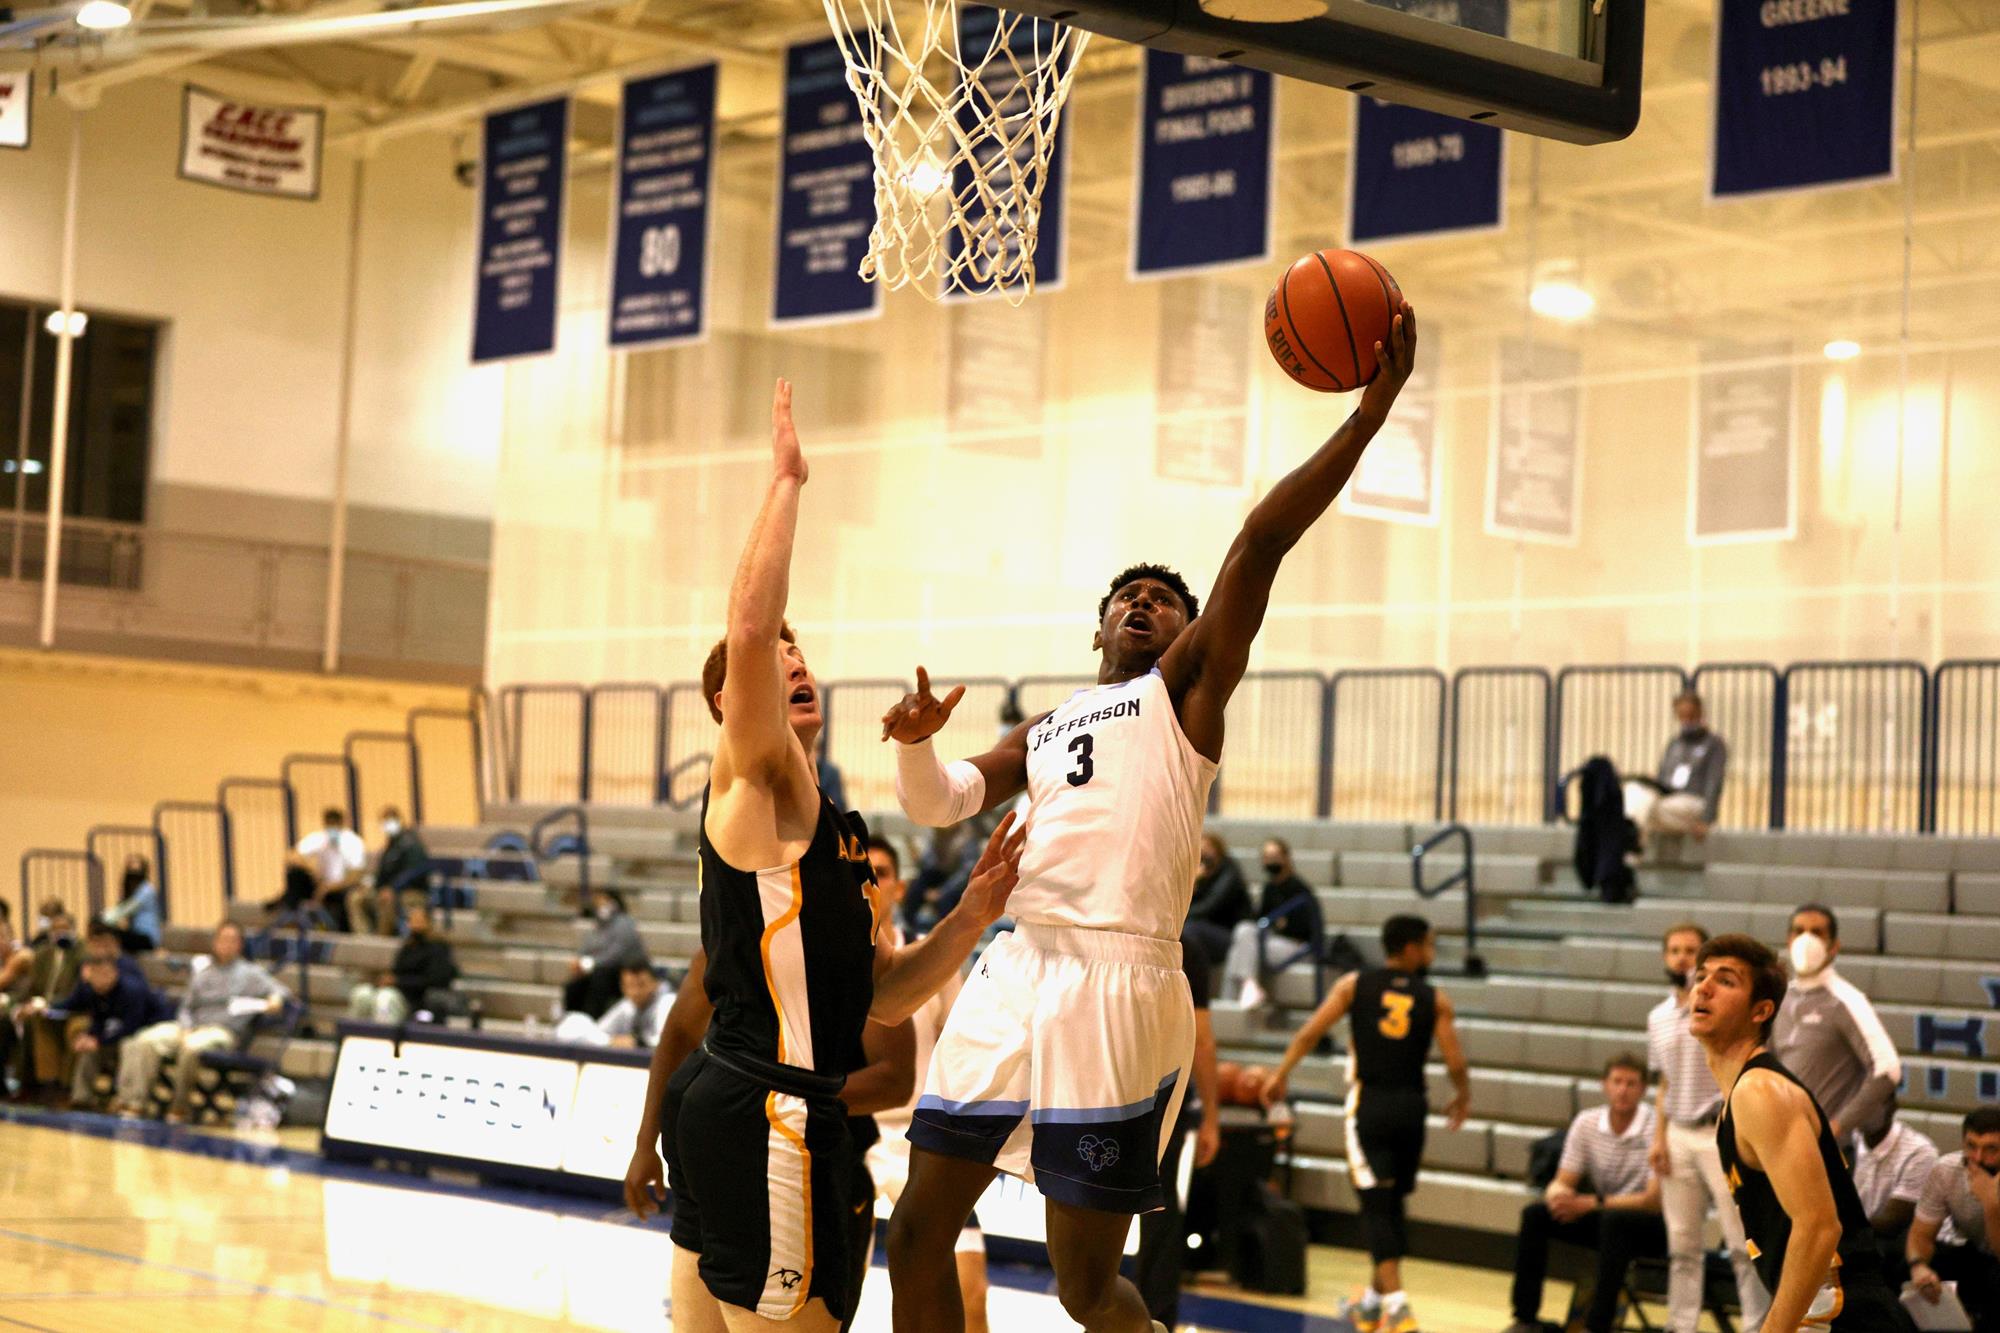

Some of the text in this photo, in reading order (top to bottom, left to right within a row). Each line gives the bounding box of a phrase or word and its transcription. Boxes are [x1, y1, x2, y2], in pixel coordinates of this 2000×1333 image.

[1269, 326, 1307, 376] ROCK
[1033, 698, 1140, 752] JEFFERSON
[1066, 733, 1094, 787] 3
[1378, 990, 1415, 1039] 3
